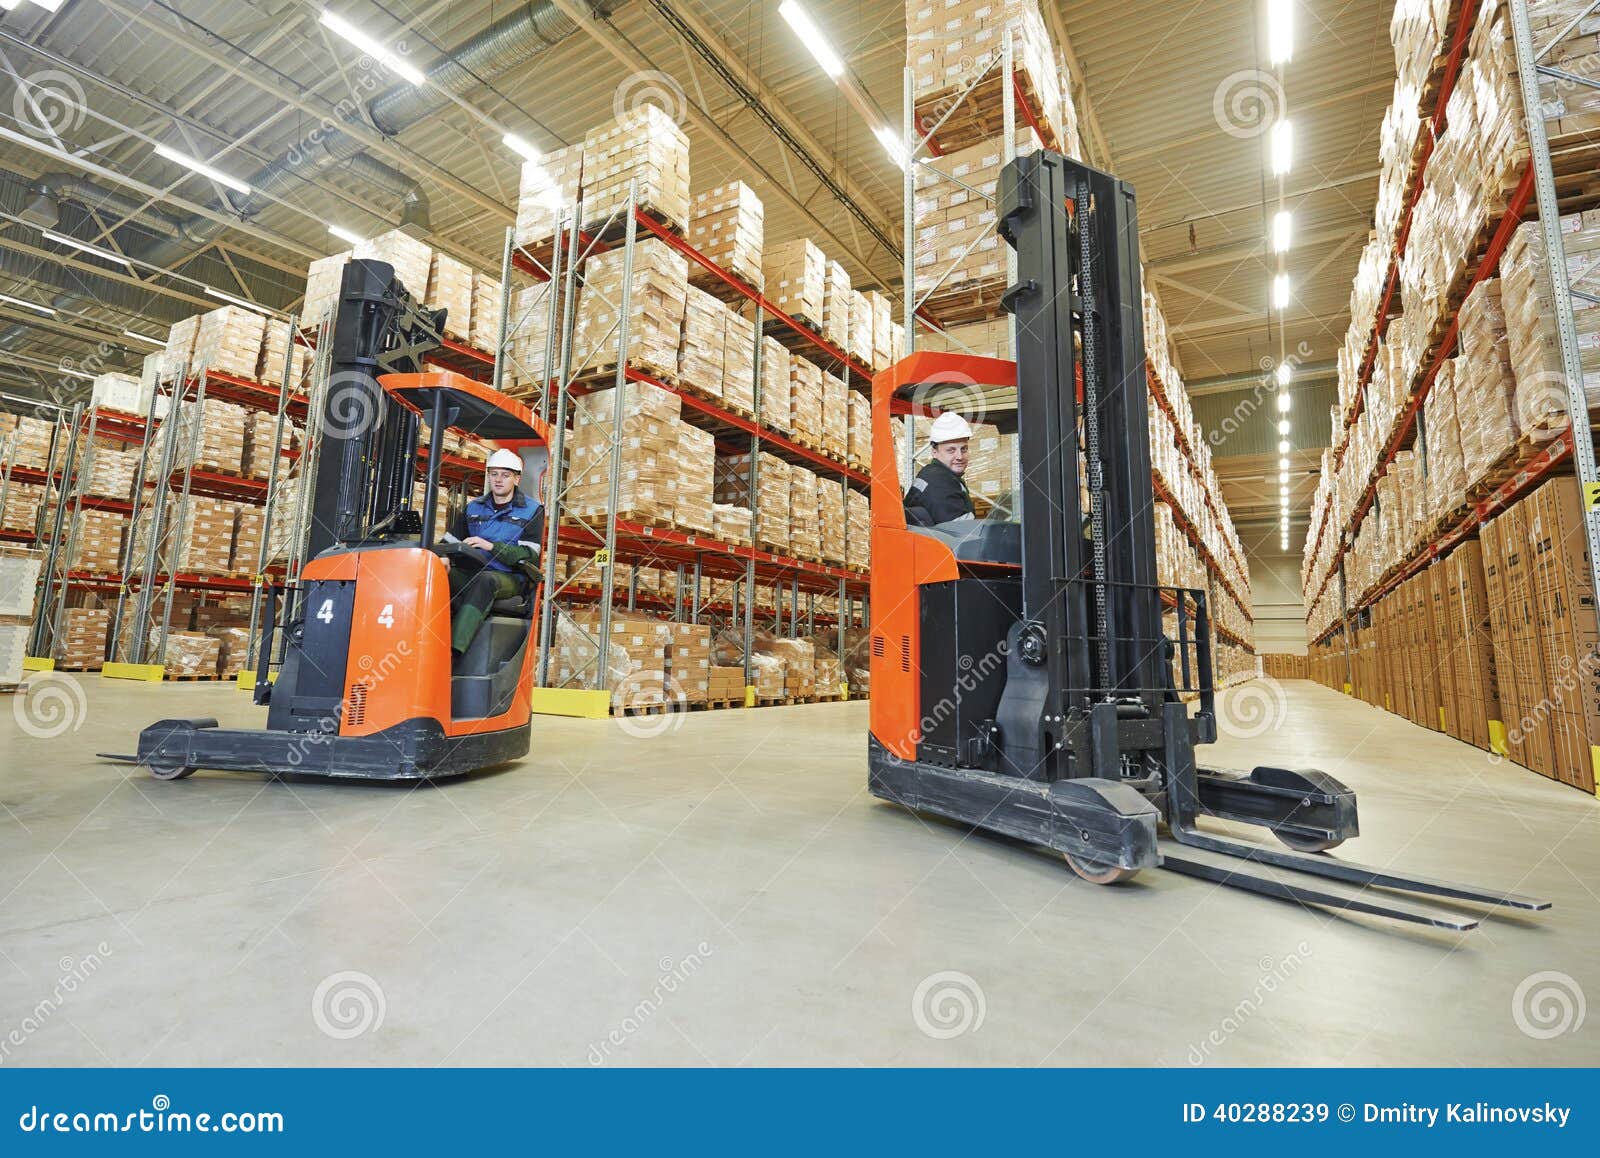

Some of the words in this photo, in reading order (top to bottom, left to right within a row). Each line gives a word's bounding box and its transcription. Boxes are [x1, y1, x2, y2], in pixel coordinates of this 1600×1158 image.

[597, 554, 608, 562] 28
[316, 599, 333, 624] 4
[377, 604, 394, 629] 4
